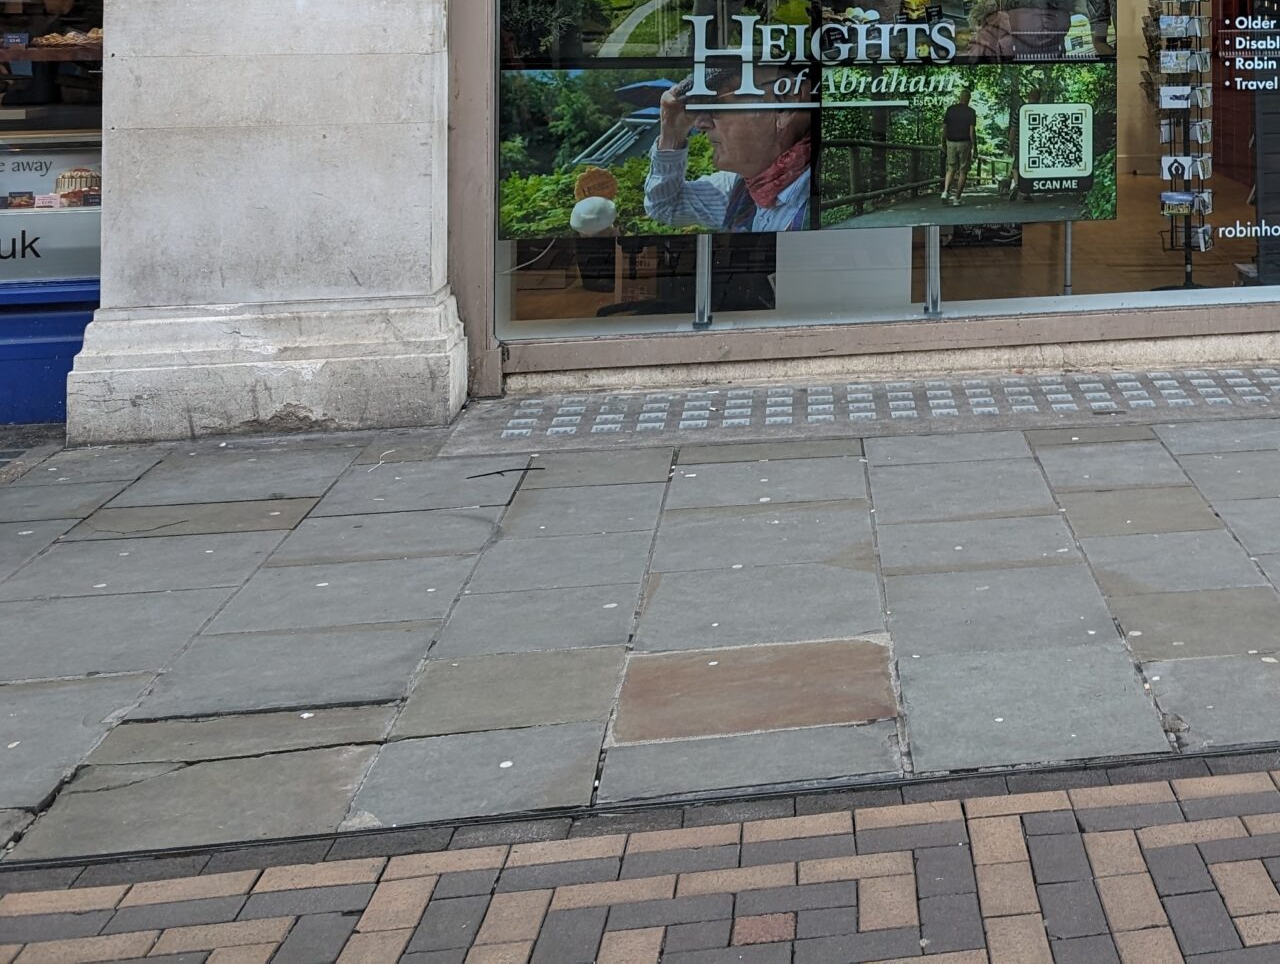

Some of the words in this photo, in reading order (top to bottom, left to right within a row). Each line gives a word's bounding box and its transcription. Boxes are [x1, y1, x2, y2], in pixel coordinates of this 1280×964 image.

[1235, 15, 1276, 29] Older
[682, 14, 957, 96] HEIGHTS
[1235, 55, 1277, 70] Robin
[773, 67, 809, 96] of
[810, 67, 954, 96] Abraham
[1235, 76, 1278, 90] Travel
[11, 160, 53, 177] away
[1033, 180, 1060, 190] SCAN
[1062, 179, 1079, 189] ME
[0, 229, 42, 259] uk
